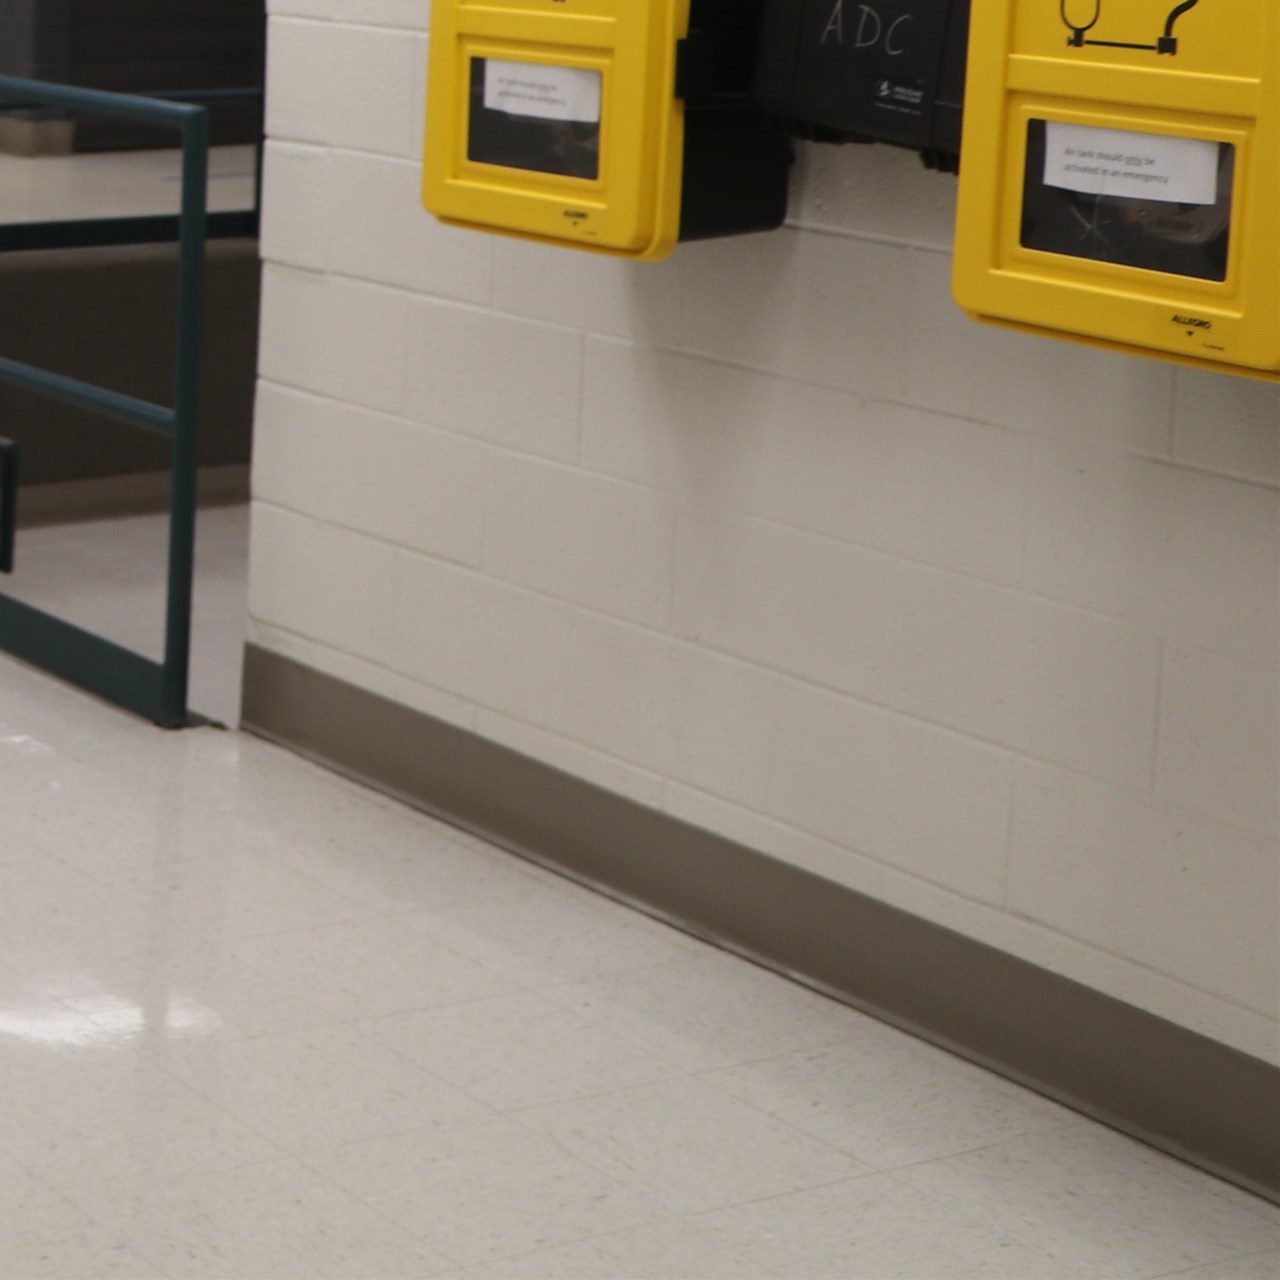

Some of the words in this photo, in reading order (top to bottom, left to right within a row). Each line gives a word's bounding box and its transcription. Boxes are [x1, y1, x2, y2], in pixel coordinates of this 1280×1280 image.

[1097, 150, 1124, 162] should
[1124, 155, 1143, 167] only
[1122, 170, 1170, 185] emergency
[1171, 314, 1212, 330] ALLEGRO
